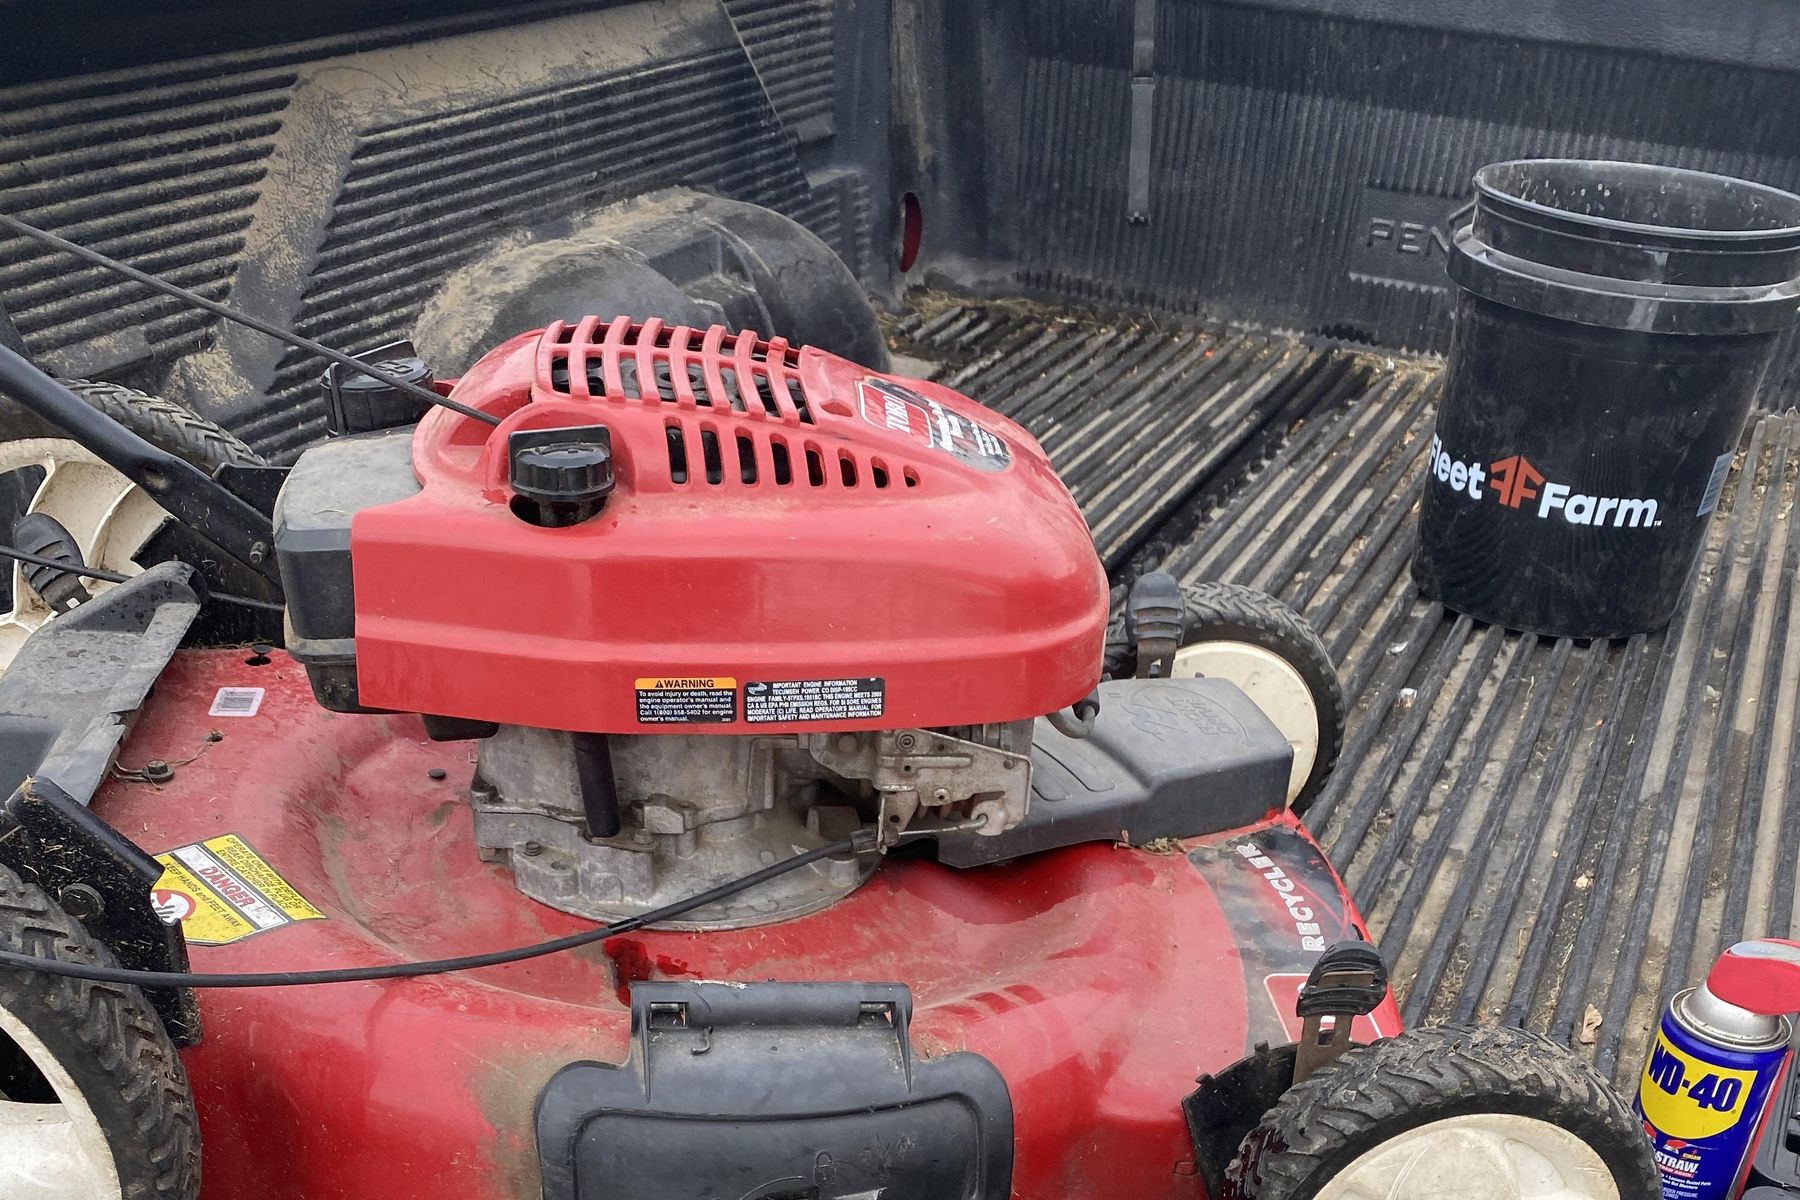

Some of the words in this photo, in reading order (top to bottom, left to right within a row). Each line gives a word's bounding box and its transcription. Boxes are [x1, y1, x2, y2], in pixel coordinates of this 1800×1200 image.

[1430, 432, 1486, 499] Fleet
[1538, 482, 1658, 527] Farm
[664, 680, 714, 688] WARNING
[199, 866, 256, 907] DANGER
[1236, 842, 1327, 951] RECYCLER
[1648, 1038, 1742, 1112] WD-40
